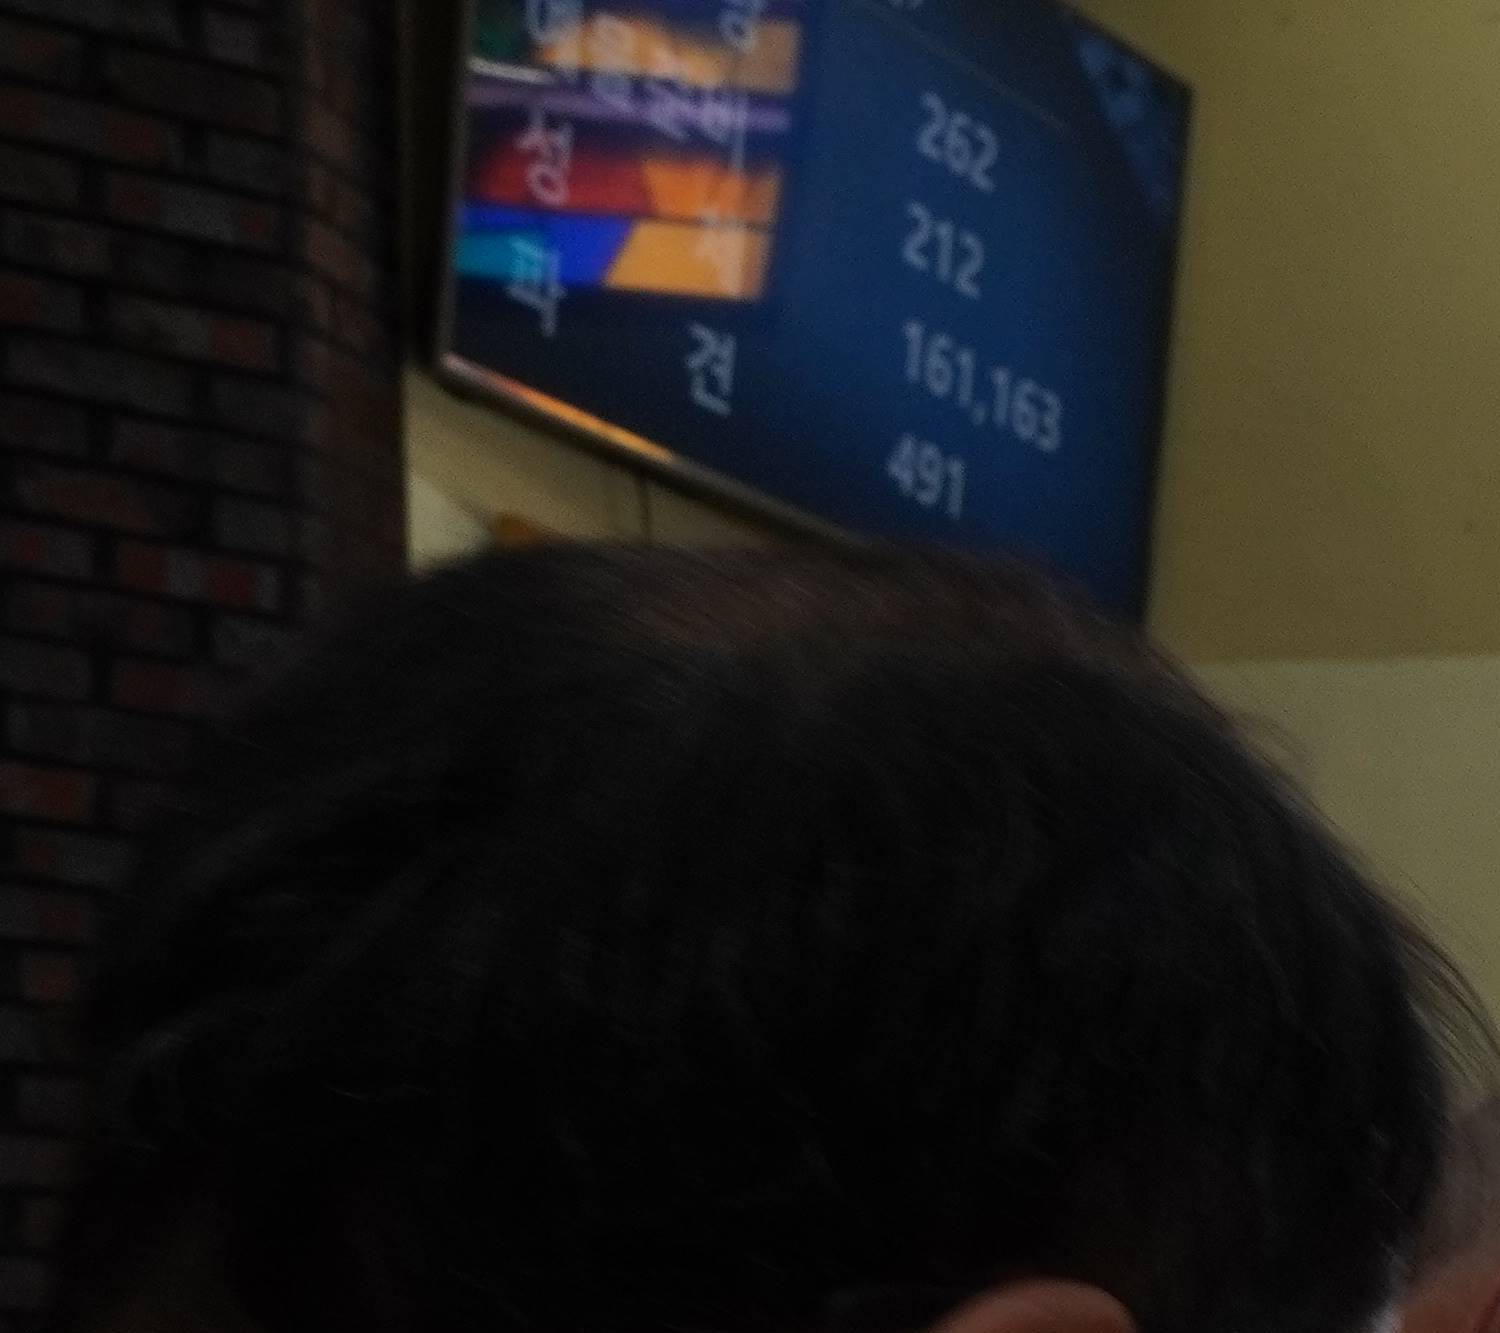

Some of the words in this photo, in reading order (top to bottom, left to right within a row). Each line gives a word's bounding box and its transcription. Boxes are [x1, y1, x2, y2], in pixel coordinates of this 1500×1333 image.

[917, 93, 999, 192] 262
[902, 203, 986, 300] 212
[904, 321, 1063, 453] 161,163
[886, 433, 966, 518] 491
